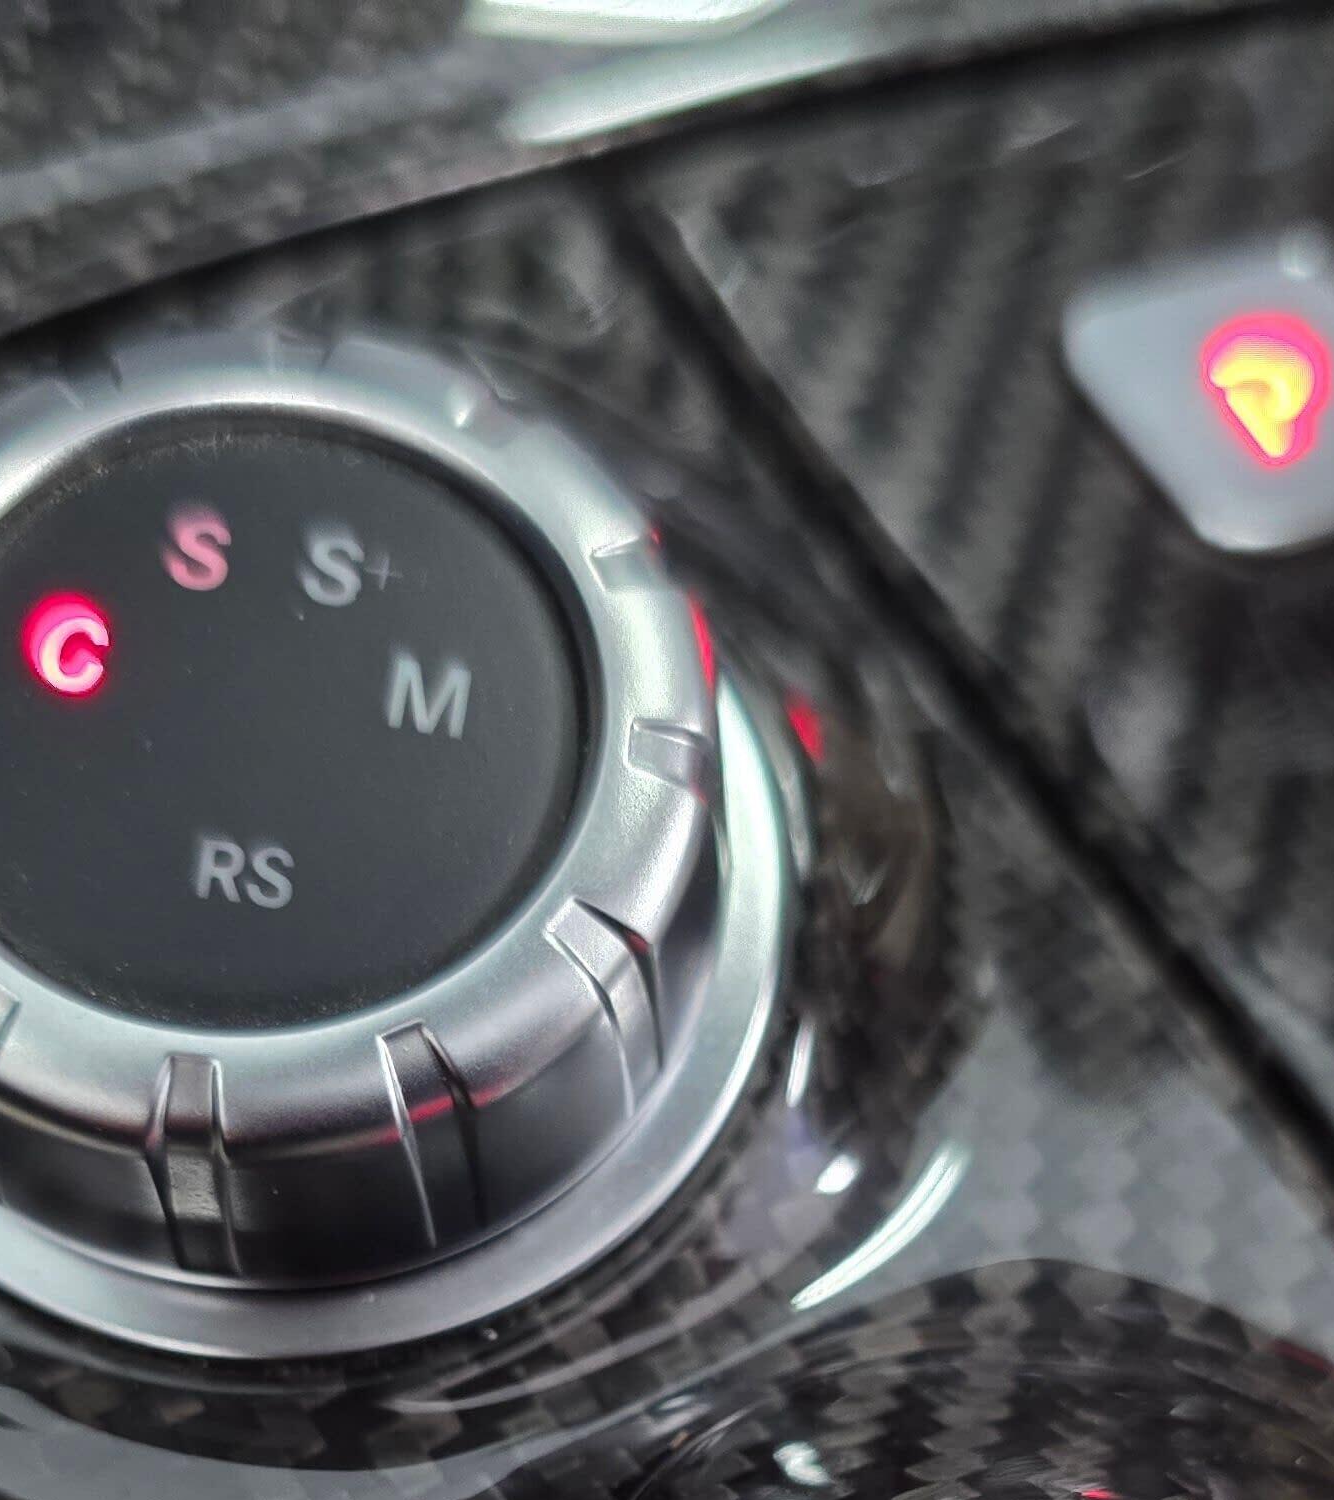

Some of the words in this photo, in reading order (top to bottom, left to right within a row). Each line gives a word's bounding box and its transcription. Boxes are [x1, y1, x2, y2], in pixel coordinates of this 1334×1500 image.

[167, 512, 231, 590] S
[301, 528, 402, 606] S+
[29, 603, 109, 692] C
[387, 652, 471, 740] M
[197, 838, 294, 909] RS
